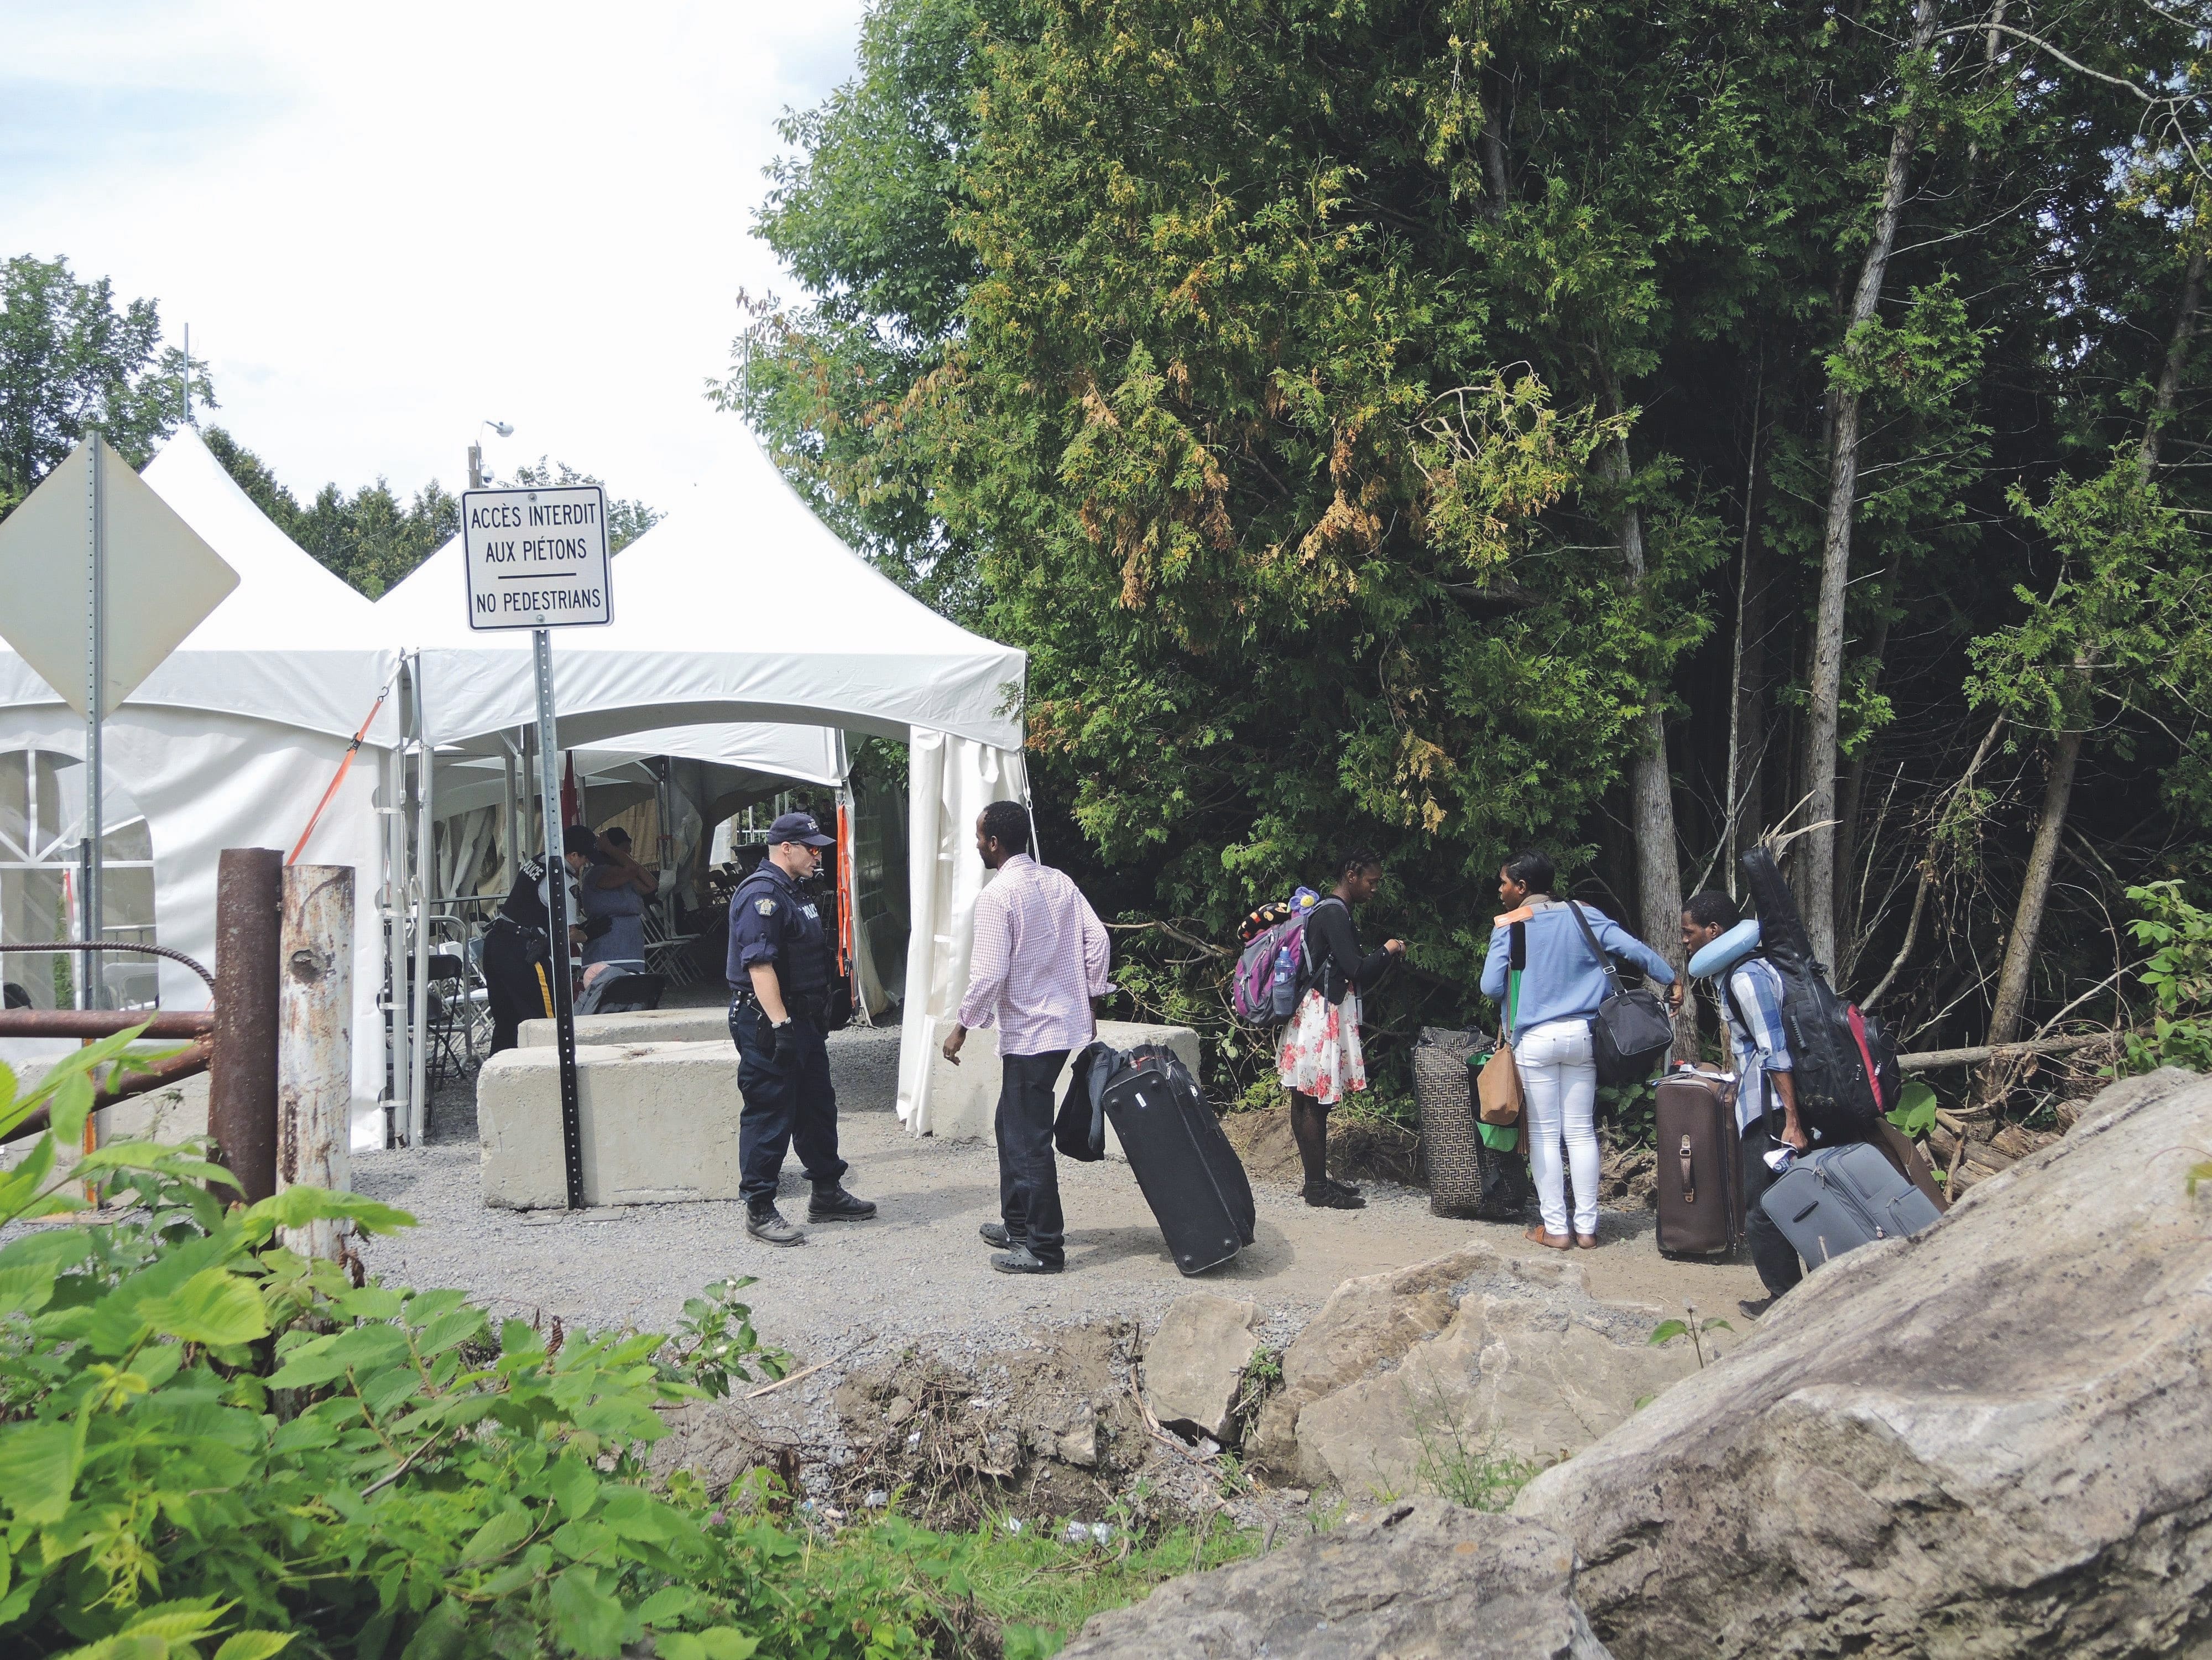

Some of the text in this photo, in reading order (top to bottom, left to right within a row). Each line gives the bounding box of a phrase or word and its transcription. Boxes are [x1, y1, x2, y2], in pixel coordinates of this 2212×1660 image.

[471, 503, 596, 529] ACCÈS INTERDIT
[486, 535, 587, 563] AUX PIÉTONS
[476, 589, 601, 613] NO PEDESTRIANS
